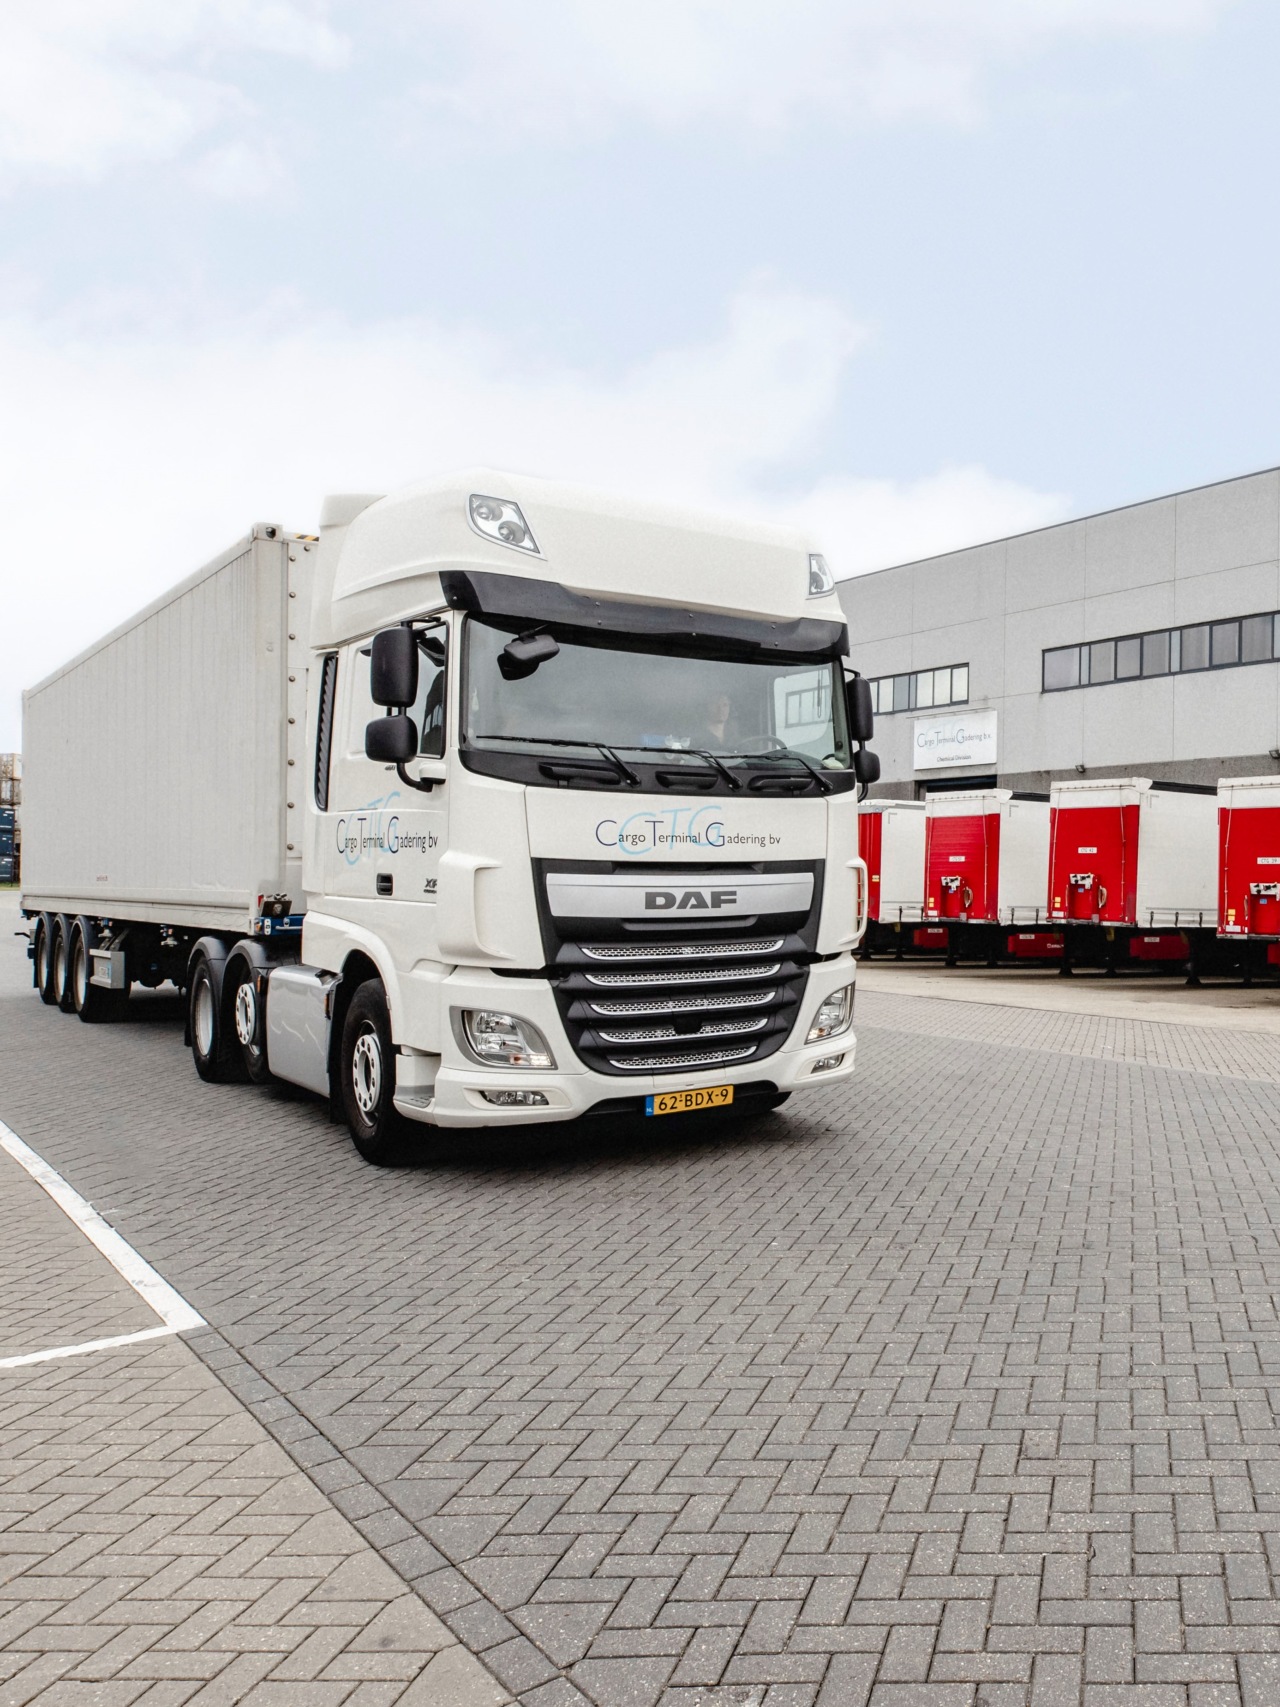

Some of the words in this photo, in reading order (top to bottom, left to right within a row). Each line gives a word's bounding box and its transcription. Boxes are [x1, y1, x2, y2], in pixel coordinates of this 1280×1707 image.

[917, 733, 935, 748] Cargo
[934, 731, 956, 746] Terminal
[336, 818, 358, 854] Cargo
[357, 817, 386, 854] Terminal
[387, 815, 427, 854] Gadering
[428, 831, 438, 849] bv
[595, 819, 646, 847] Cargo
[645, 820, 701, 847] Terminal
[705, 822, 766, 848] Gadering
[769, 833, 781, 845] bv
[645, 891, 737, 910] DAF
